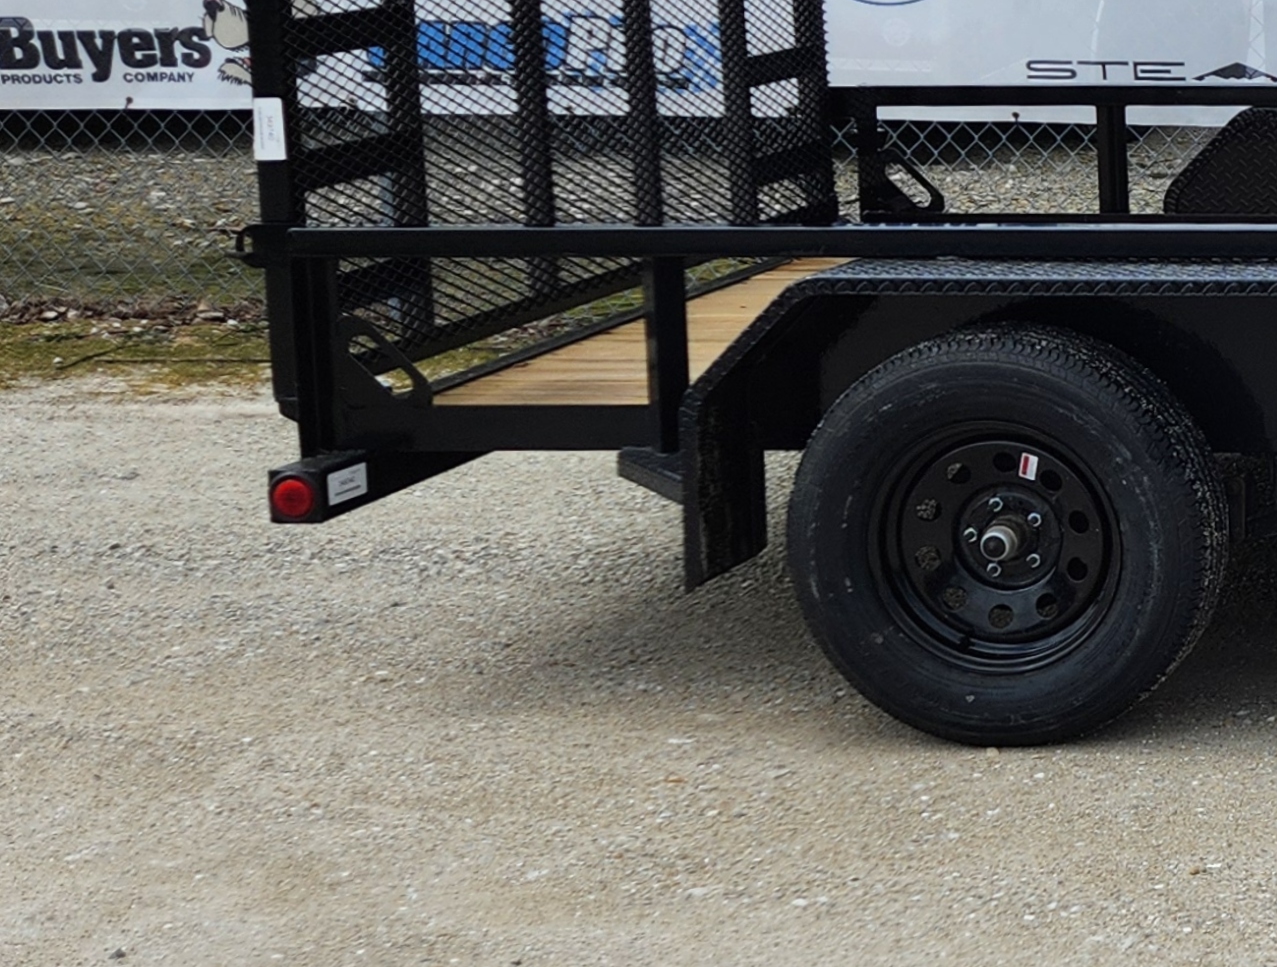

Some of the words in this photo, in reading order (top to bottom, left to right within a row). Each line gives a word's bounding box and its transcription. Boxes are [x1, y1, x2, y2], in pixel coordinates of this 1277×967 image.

[0, 15, 212, 83] Buyers
[0, 72, 83, 84] PRODUCTS
[122, 71, 195, 83] COMPANY
